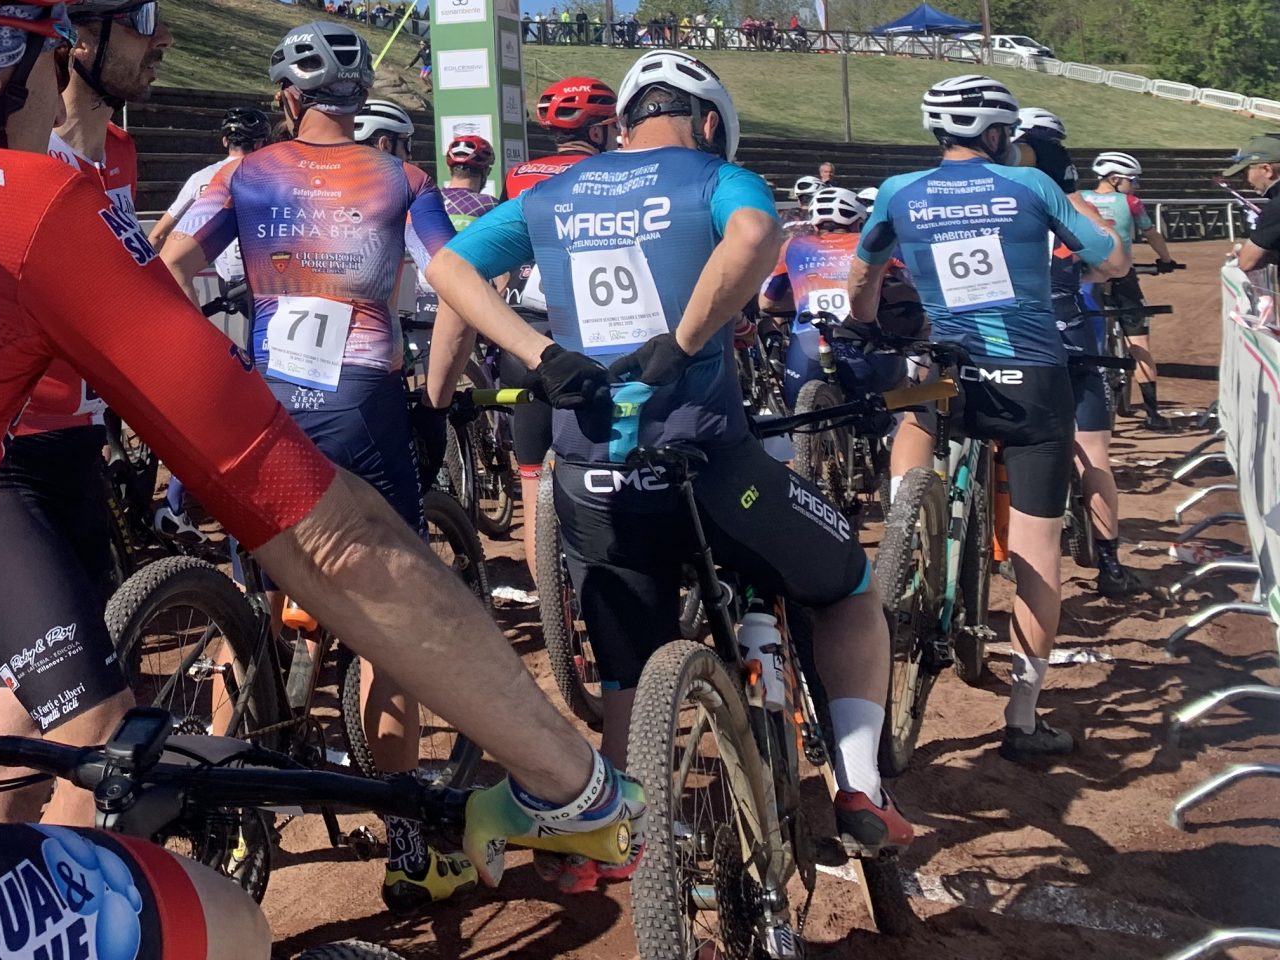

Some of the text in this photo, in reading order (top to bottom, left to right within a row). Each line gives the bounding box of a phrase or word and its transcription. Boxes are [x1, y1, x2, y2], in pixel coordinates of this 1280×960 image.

[284, 33, 315, 46] KASK
[337, 71, 360, 79] KASK
[563, 85, 592, 94] KASK
[571, 174, 659, 196] AUTOTRASPORTI
[926, 184, 995, 194] AUTOTRASPORTI
[554, 203, 573, 213] CICLI
[908, 199, 928, 209] Cicli
[909, 204, 990, 222] MAGGI
[271, 207, 326, 220] TEAM
[257, 224, 379, 241] SIENA BIKE
[554, 208, 640, 241] MAGGI
[933, 229, 978, 242] HABITAT
[798, 261, 835, 271] SIENA
[948, 248, 994, 280] 63
[588, 265, 639, 307] 69
[816, 293, 846, 311] 60
[286, 310, 329, 349] 71
[960, 365, 1023, 385] CM2
[290, 395, 325, 405] SIENA
[294, 390, 324, 398] TEAM
[294, 402, 320, 410] BIKE
[583, 465, 670, 493] CM2
[788, 481, 838, 529] MAGGI
[9, 623, 77, 672] Roby & Roy
[53, 640, 82, 658] EDICOLA
[36, 655, 65, 675] Villanova
[37, 699, 55, 718] Forti
[58, 682, 86, 704] Liberi
[62, 696, 80, 715] cicli
[551, 811, 570, 821] NO
[55, 860, 95, 914] &
